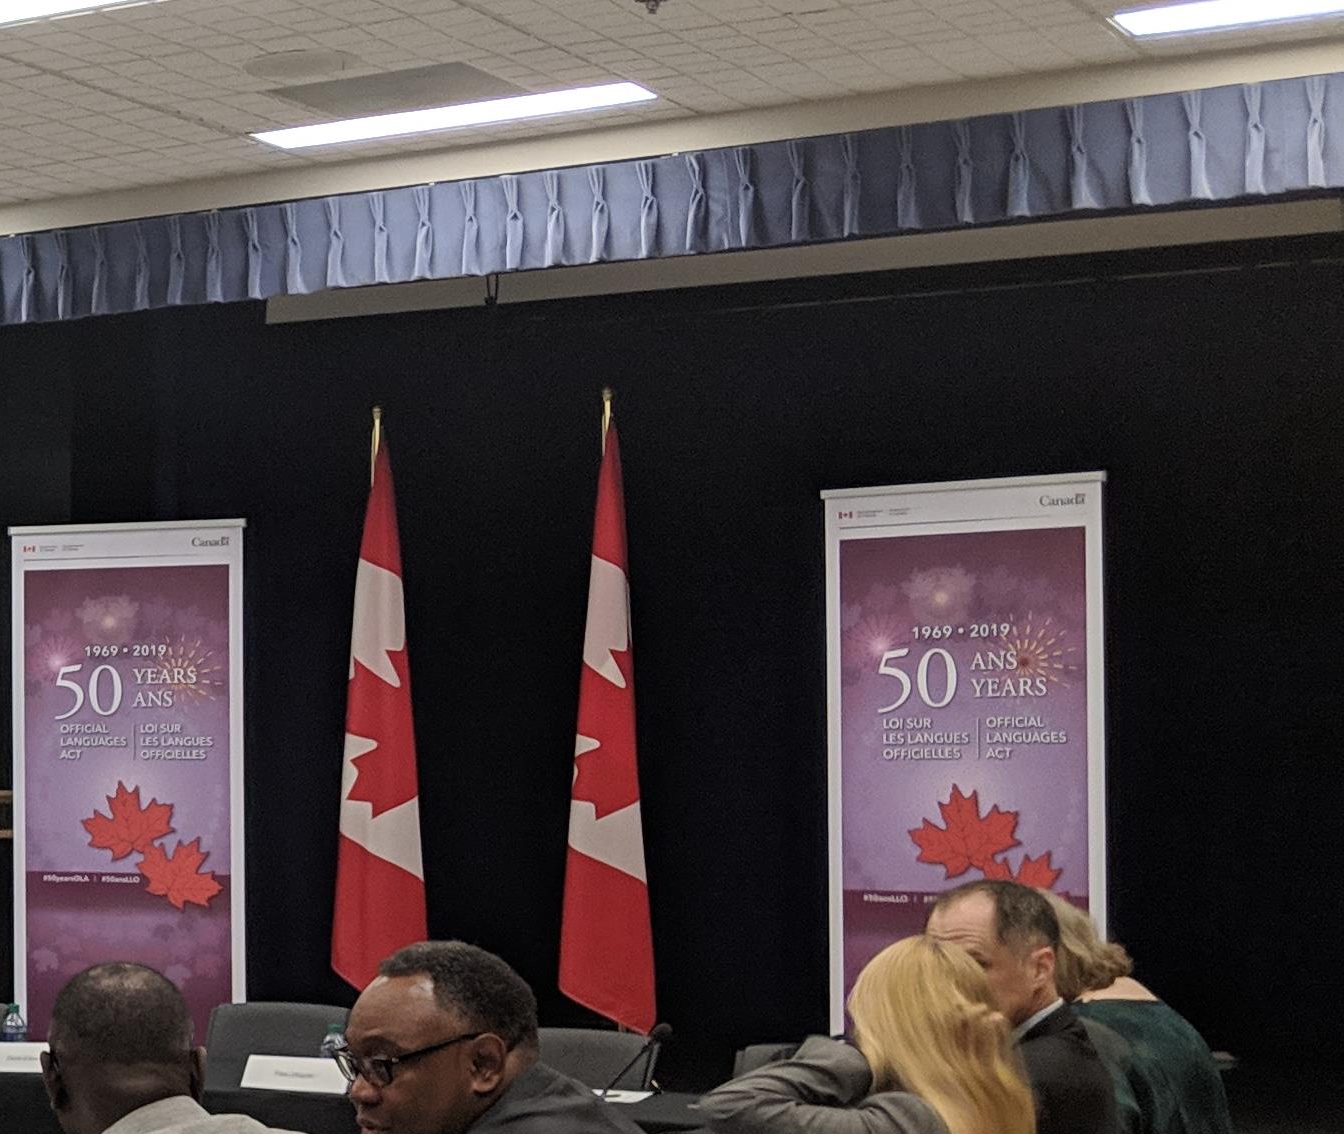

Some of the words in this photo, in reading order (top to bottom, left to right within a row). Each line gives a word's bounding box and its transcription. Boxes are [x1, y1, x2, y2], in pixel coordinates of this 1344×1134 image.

[1039, 493, 1085, 507] Canada
[191, 536, 229, 547] Canada
[912, 626, 952, 639] 1969
[970, 623, 1010, 638] 2019
[85, 645, 118, 657] 1969
[132, 644, 167, 657] 2019
[970, 651, 1018, 671] ANS
[133, 668, 197, 685] YEARS
[878, 648, 957, 714] 50
[55, 663, 122, 720] 50
[971, 677, 1048, 697] YEARS
[133, 691, 173, 707] ANS
[883, 718, 904, 729] LOI
[907, 718, 931, 729] SUR
[986, 717, 1044, 728] OFFICIAL
[60, 723, 109, 734] OFFICIAL
[140, 723, 158, 734] LOI
[160, 723, 181, 734] SUR
[60, 736, 128, 747] LANGUAGES
[140, 736, 159, 746] LES
[162, 736, 213, 746] LANGUES
[883, 733, 905, 744] LES
[908, 733, 969, 744] LANGUES
[986, 732, 1067, 743] LANGUAGES
[60, 749, 82, 760] ACT
[140, 749, 206, 760] OFFICIELLES
[883, 748, 961, 759] OFFICIELLES
[986, 748, 1012, 759] ACT
